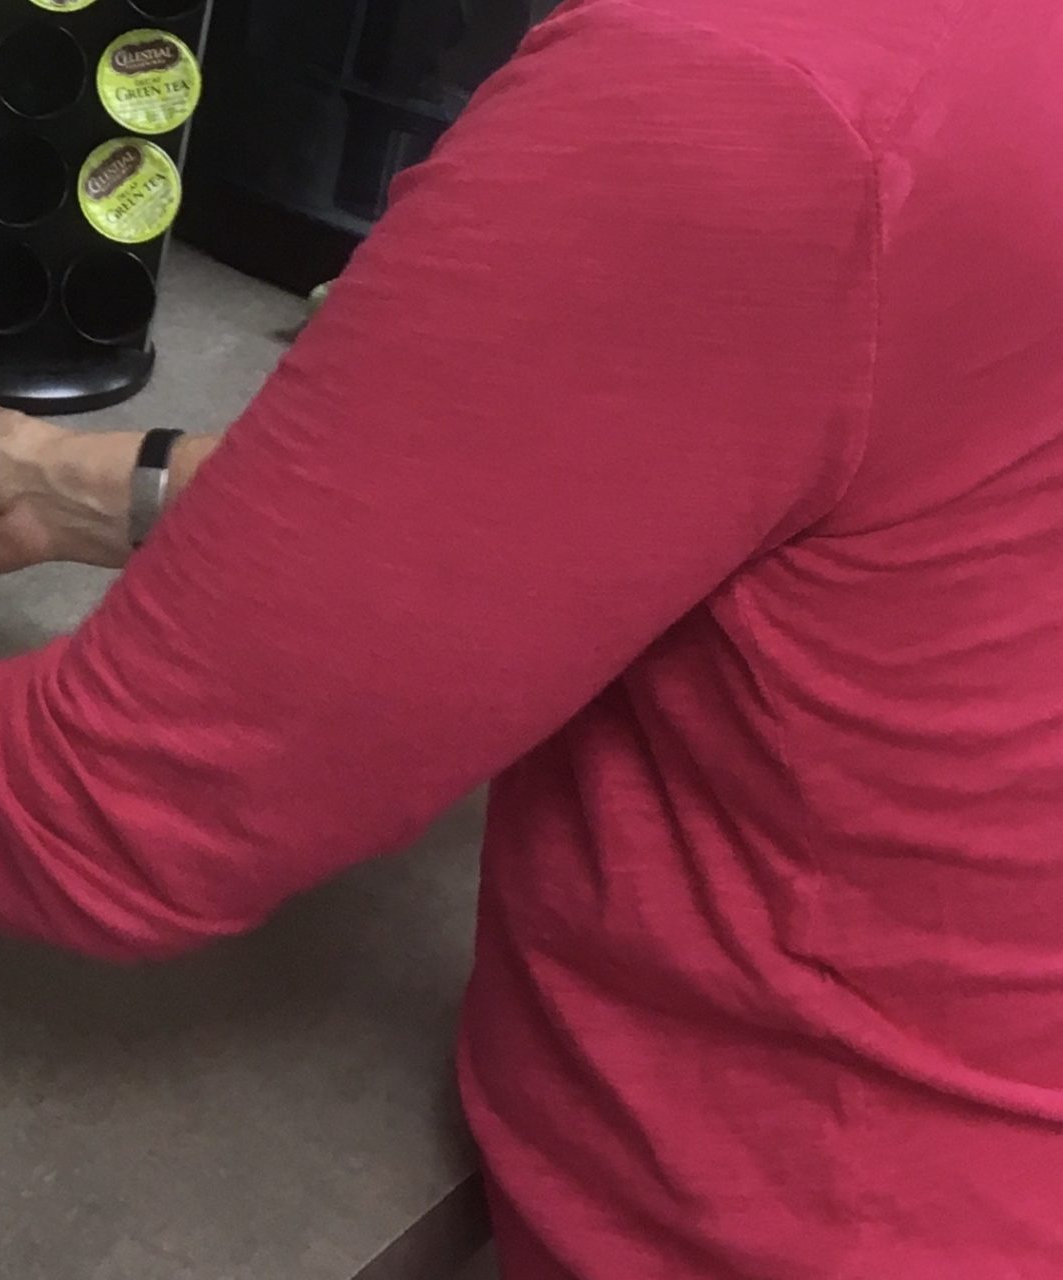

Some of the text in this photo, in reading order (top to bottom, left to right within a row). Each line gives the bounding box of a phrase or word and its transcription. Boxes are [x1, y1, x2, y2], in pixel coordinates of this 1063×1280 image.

[114, 46, 173, 67] CELESTIAL
[115, 80, 190, 102] GREEN TEA
[88, 151, 135, 194] CELESTIAL
[106, 191, 145, 224] GREEN
[143, 173, 167, 192] TEA
